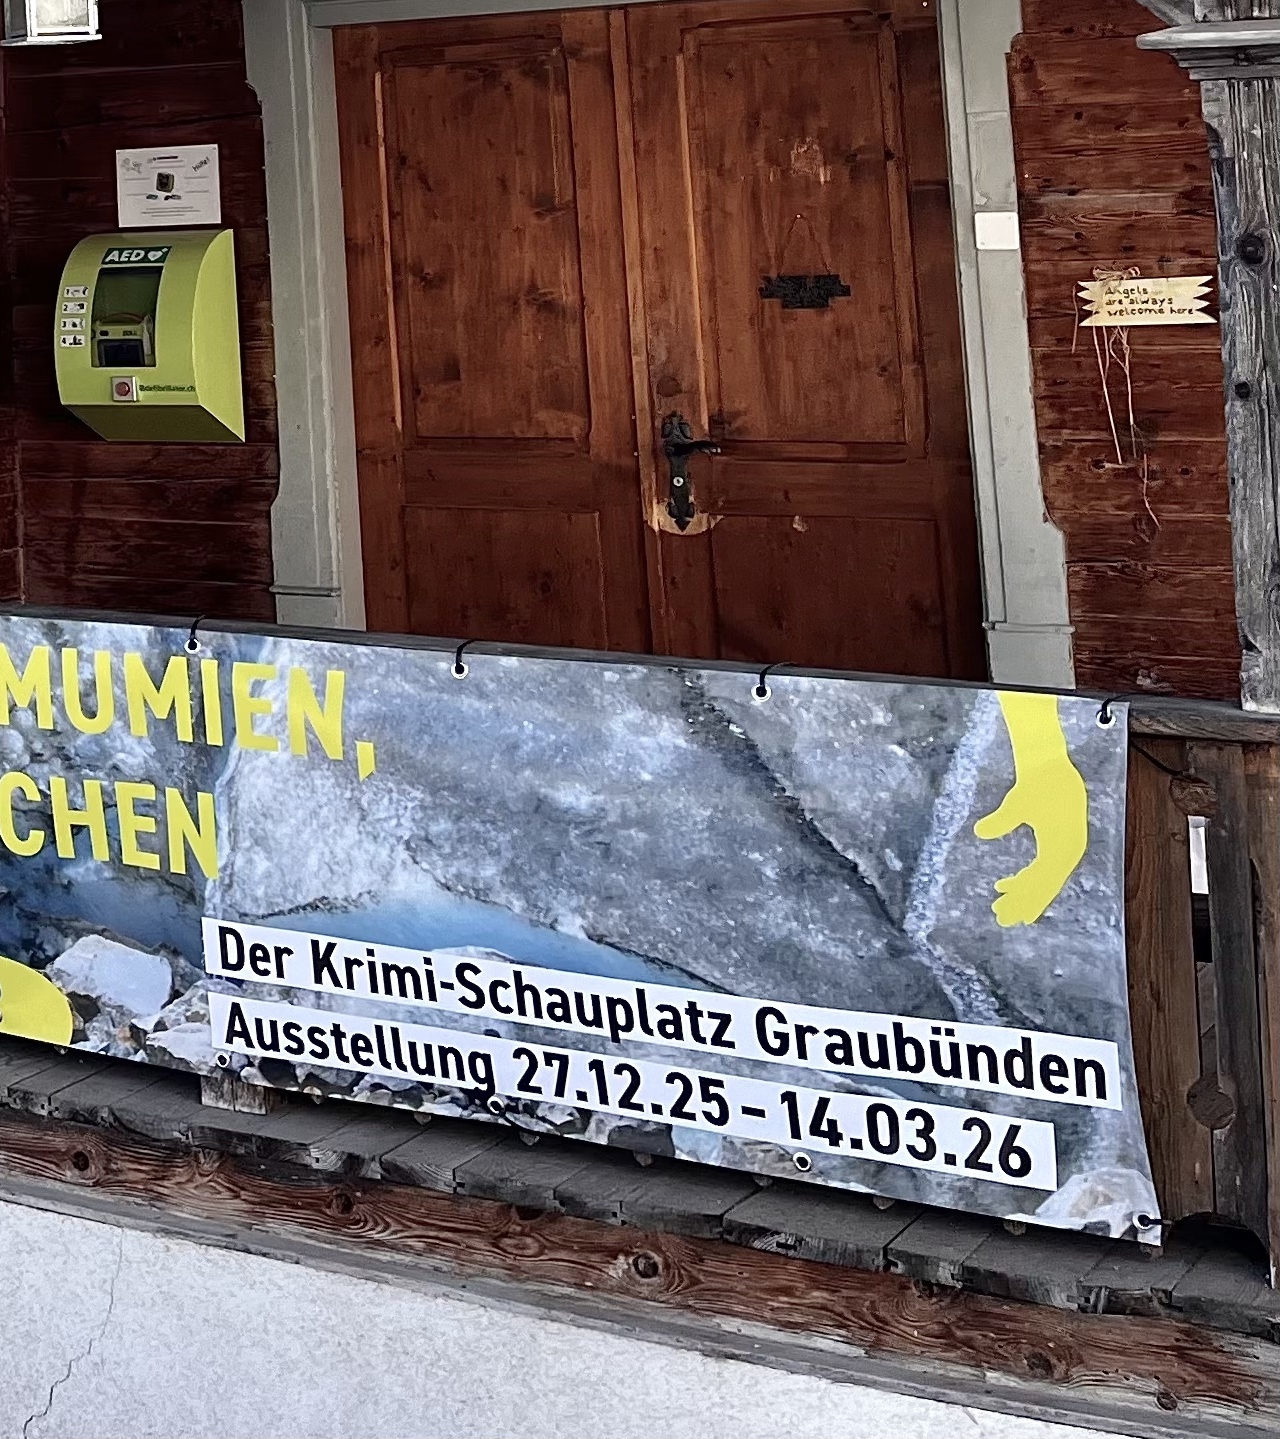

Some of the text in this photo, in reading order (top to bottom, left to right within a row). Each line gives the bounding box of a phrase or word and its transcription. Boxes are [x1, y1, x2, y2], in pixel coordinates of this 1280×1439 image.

[105, 249, 145, 262] AED
[1104, 285, 1148, 299] Angels
[1105, 297, 1173, 307] are always
[1107, 306, 1194, 317] welcome here
[217, 925, 1107, 1100] Der Krimi-Schauplatz Graubünden
[225, 1002, 496, 1092] Ausstellung
